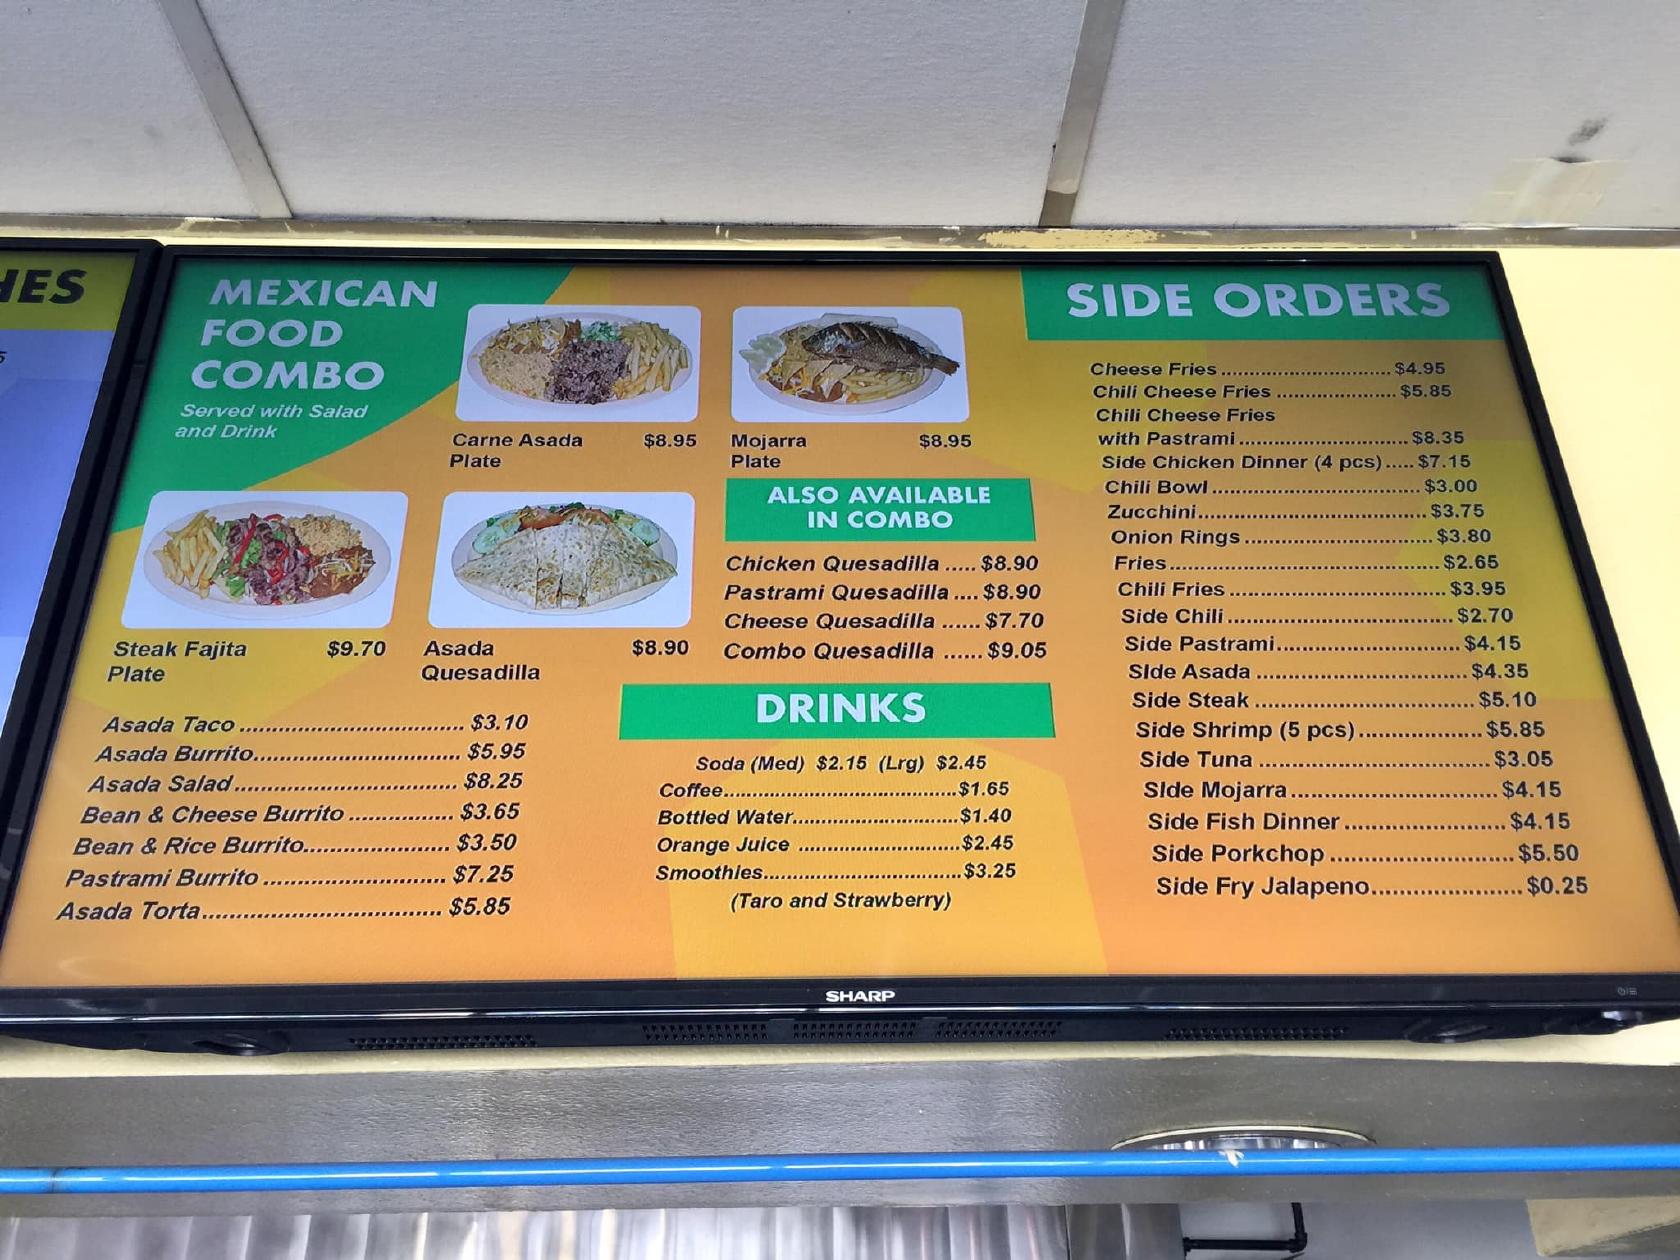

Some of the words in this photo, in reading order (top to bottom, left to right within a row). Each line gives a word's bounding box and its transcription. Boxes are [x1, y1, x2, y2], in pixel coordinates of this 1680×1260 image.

[209, 279, 437, 307] MEXICAN
[1067, 283, 1193, 318] SIDE
[1214, 283, 1449, 317] ORDERS
[201, 319, 343, 347] FOOD
[191, 360, 384, 390] COMBO
[1090, 362, 1162, 376] Cheese
[1169, 362, 1217, 376] Fries
[1395, 362, 1445, 376] $4.95
[1093, 385, 1137, 399] Chili
[1144, 385, 1217, 398] Cheese
[1223, 385, 1271, 398] Fries
[1400, 384, 1452, 399] $5.85
[180, 404, 256, 418] Served
[261, 404, 303, 418] with
[309, 404, 368, 418] Salad
[1096, 408, 1141, 422] Chili
[1147, 408, 1221, 422] Cheese
[1227, 408, 1275, 422] Fries
[175, 424, 217, 438] and
[220, 424, 277, 438] Drink
[1098, 432, 1140, 445] with
[1147, 431, 1235, 445] Pastrami
[1412, 431, 1464, 446] $8.35
[453, 433, 513, 447] Carne
[518, 433, 582, 447] Asada
[644, 433, 697, 449] $8.95
[732, 434, 807, 450] Mojarra
[919, 434, 971, 449] $8.95
[450, 454, 501, 468] Plate
[732, 454, 781, 468] Plate
[1102, 455, 1146, 469] Side
[1153, 455, 1234, 469] Chicken
[1242, 455, 1308, 469] Dinner
[1315, 455, 1333, 472] (4
[1340, 455, 1382, 472] pcs)
[1418, 454, 1471, 470] $7.15
[768, 486, 839, 504] ALSO
[849, 486, 990, 504] AVAILABLE
[1105, 480, 1151, 494] Chili
[1157, 480, 1208, 494] Bowl
[1424, 478, 1477, 495] $3.00
[808, 511, 837, 528] IN
[848, 511, 953, 528] COMBO
[1107, 504, 1196, 519] Zucchini
[1431, 503, 1484, 519] $3.75
[1111, 530, 1172, 544] Onion
[1181, 530, 1240, 547] Rings
[1437, 528, 1491, 545] $3.80
[726, 555, 815, 571] Chicken
[823, 555, 939, 573] Quesadilla
[981, 555, 1039, 573] $8.90
[1115, 555, 1166, 570] Fries
[1444, 554, 1499, 570] $2.65
[724, 584, 825, 600] Pastrami
[832, 584, 948, 601] Quesadilla
[983, 583, 1041, 601] $8.90
[1118, 582, 1166, 596] Chili
[1172, 582, 1225, 596] Fries
[1450, 581, 1506, 597] $3.95
[725, 613, 808, 629] Cheese
[816, 613, 935, 630] Quesadilla
[985, 612, 1044, 630] $7.70
[1121, 608, 1168, 624] Side
[1175, 608, 1223, 624] Chili
[1458, 607, 1513, 624] $2.70
[114, 641, 178, 657] Steak
[184, 641, 247, 660] Fajita
[327, 640, 386, 658] $9.70
[423, 640, 494, 656] Asada
[632, 639, 689, 657] $8.90
[724, 642, 806, 660] Combo
[814, 642, 934, 660] Quesadilla
[987, 641, 1047, 660] $9.05
[1125, 636, 1172, 651] Side
[1180, 635, 1274, 651] Pastrami
[1464, 635, 1521, 652] $4.15
[107, 666, 165, 682] Plate
[422, 664, 540, 681] Quesadilla
[1182, 664, 1250, 679] Asada
[1472, 663, 1528, 680] $4.35
[757, 692, 926, 723] DRINKS
[1132, 692, 1181, 708] Side
[1188, 691, 1249, 708] Steak
[1479, 691, 1536, 709] $5.10
[102, 716, 175, 733] Asada
[184, 716, 235, 733] Taco
[471, 714, 528, 732] $3.10
[1136, 721, 1185, 738] Side
[1193, 721, 1272, 742] Shrimp
[1280, 721, 1300, 742] (5
[1307, 721, 1354, 742] pcs)
[1486, 720, 1545, 739] $5.85
[94, 745, 168, 762] Asada
[173, 745, 254, 762] Burrito
[467, 742, 526, 761] $5.95
[1140, 751, 1190, 768] Side
[1197, 751, 1252, 767] Tuna
[1494, 750, 1553, 770] $3.05
[696, 756, 745, 771] Soda
[751, 756, 805, 774] (Med)
[816, 755, 867, 772] $2.15
[879, 755, 924, 774] (Lrg)
[936, 755, 986, 771] $2.45
[87, 775, 161, 793] Asada
[168, 774, 234, 792] Salad
[464, 771, 523, 791] $8.25
[660, 783, 723, 798] Coffee
[958, 781, 1009, 797] $1.65
[1202, 781, 1286, 802] Mojarra
[1502, 780, 1561, 800] $4.15
[80, 806, 141, 824] Bean
[148, 806, 163, 823] &
[172, 805, 257, 823] Cheese
[263, 805, 344, 822] Burrito
[460, 802, 520, 822] $3.65
[658, 810, 730, 825] Bottled
[737, 809, 794, 824] Water
[960, 807, 1012, 825] $1.40
[1148, 812, 1199, 830] Side
[1207, 812, 1254, 830] Fish
[1263, 812, 1340, 830] Dinner
[1510, 811, 1570, 832] $4.15
[72, 837, 134, 855] Bean
[141, 837, 157, 855] &
[163, 837, 216, 855] Rice
[222, 836, 304, 854] Burrito
[456, 833, 517, 853] $3.50
[657, 837, 730, 856] Orange
[736, 836, 790, 852] Juice
[962, 834, 1013, 852] $2.45
[1152, 844, 1203, 862] Side
[1212, 844, 1324, 866] Porkchop
[1518, 843, 1579, 864] $5.50
[65, 869, 172, 888] Pastrami
[175, 868, 259, 886] Burrito
[453, 864, 514, 884] $7.25
[656, 865, 763, 881] Smoothies
[964, 862, 1016, 880] $3.25
[1157, 877, 1208, 895] Side
[1216, 877, 1254, 899] Fry
[1261, 876, 1369, 899] Jalapeno
[1527, 875, 1588, 897] $0.25
[55, 901, 133, 920] Asada
[143, 901, 200, 920] Torta
[449, 896, 511, 917] $5.85
[731, 893, 783, 913] (Taro
[789, 892, 828, 908] and
[833, 892, 951, 911] Strawberry)
[826, 990, 895, 1002] SHARP
